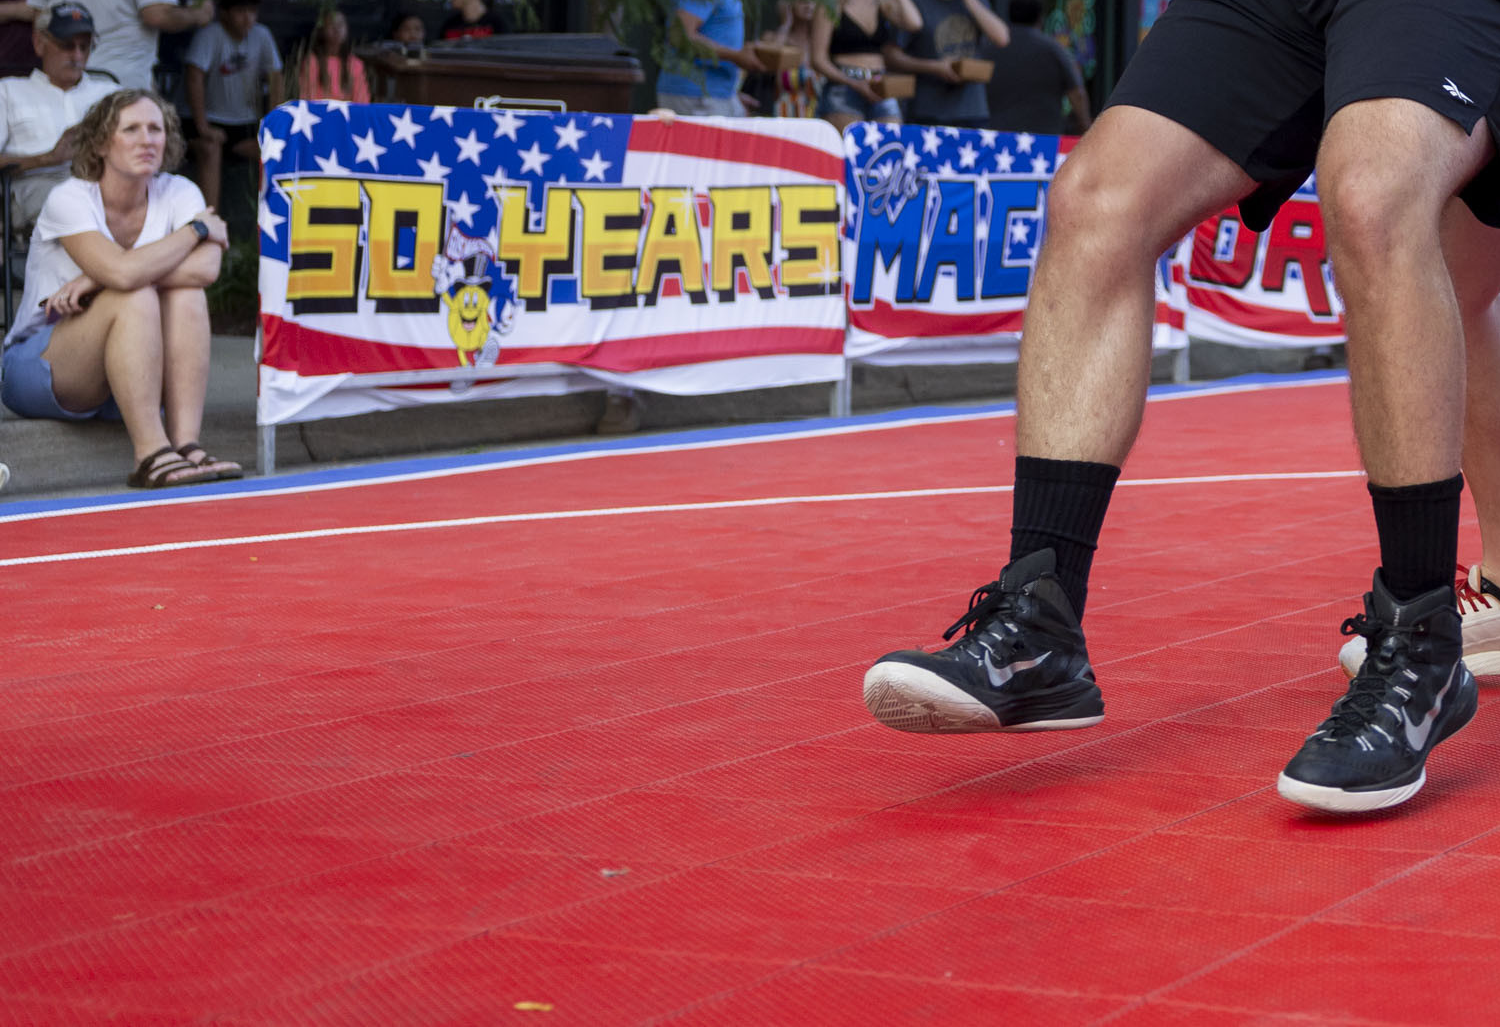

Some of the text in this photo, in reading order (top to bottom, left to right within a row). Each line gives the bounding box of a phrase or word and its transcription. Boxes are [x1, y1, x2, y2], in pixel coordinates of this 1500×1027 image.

[275, 176, 843, 315] 50 YEARS
[853, 178, 1048, 305] MAC
